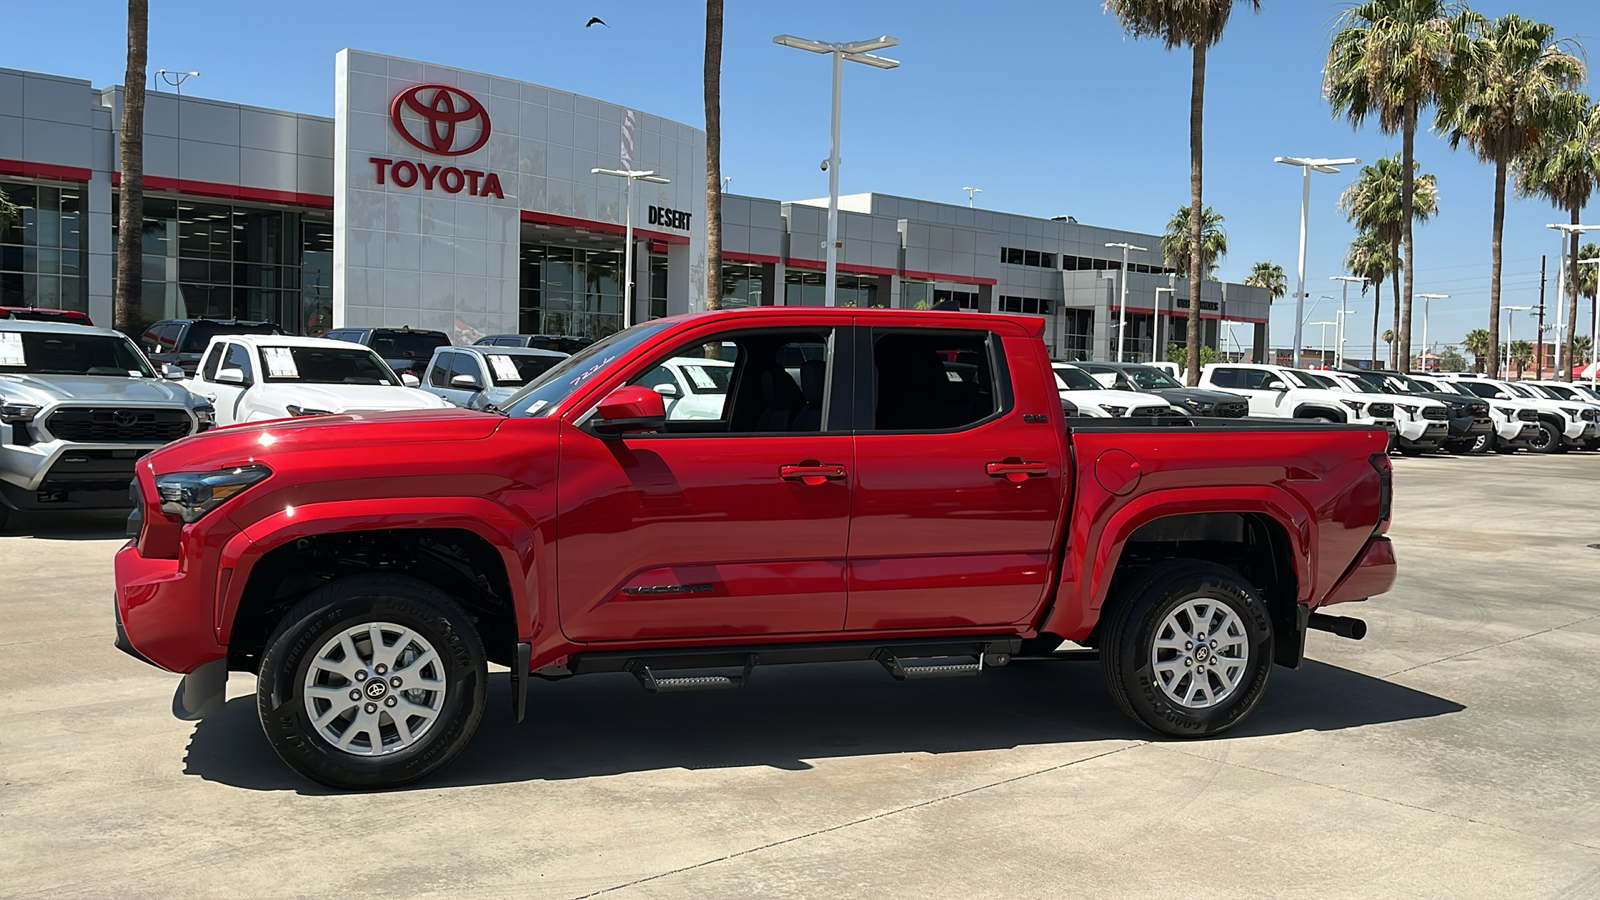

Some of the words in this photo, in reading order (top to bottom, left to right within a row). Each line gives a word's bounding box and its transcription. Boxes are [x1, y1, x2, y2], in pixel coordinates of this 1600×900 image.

[369, 157, 505, 199] TOYOTA
[648, 205, 692, 231] DESERT
[622, 583, 713, 595] TACOMA
